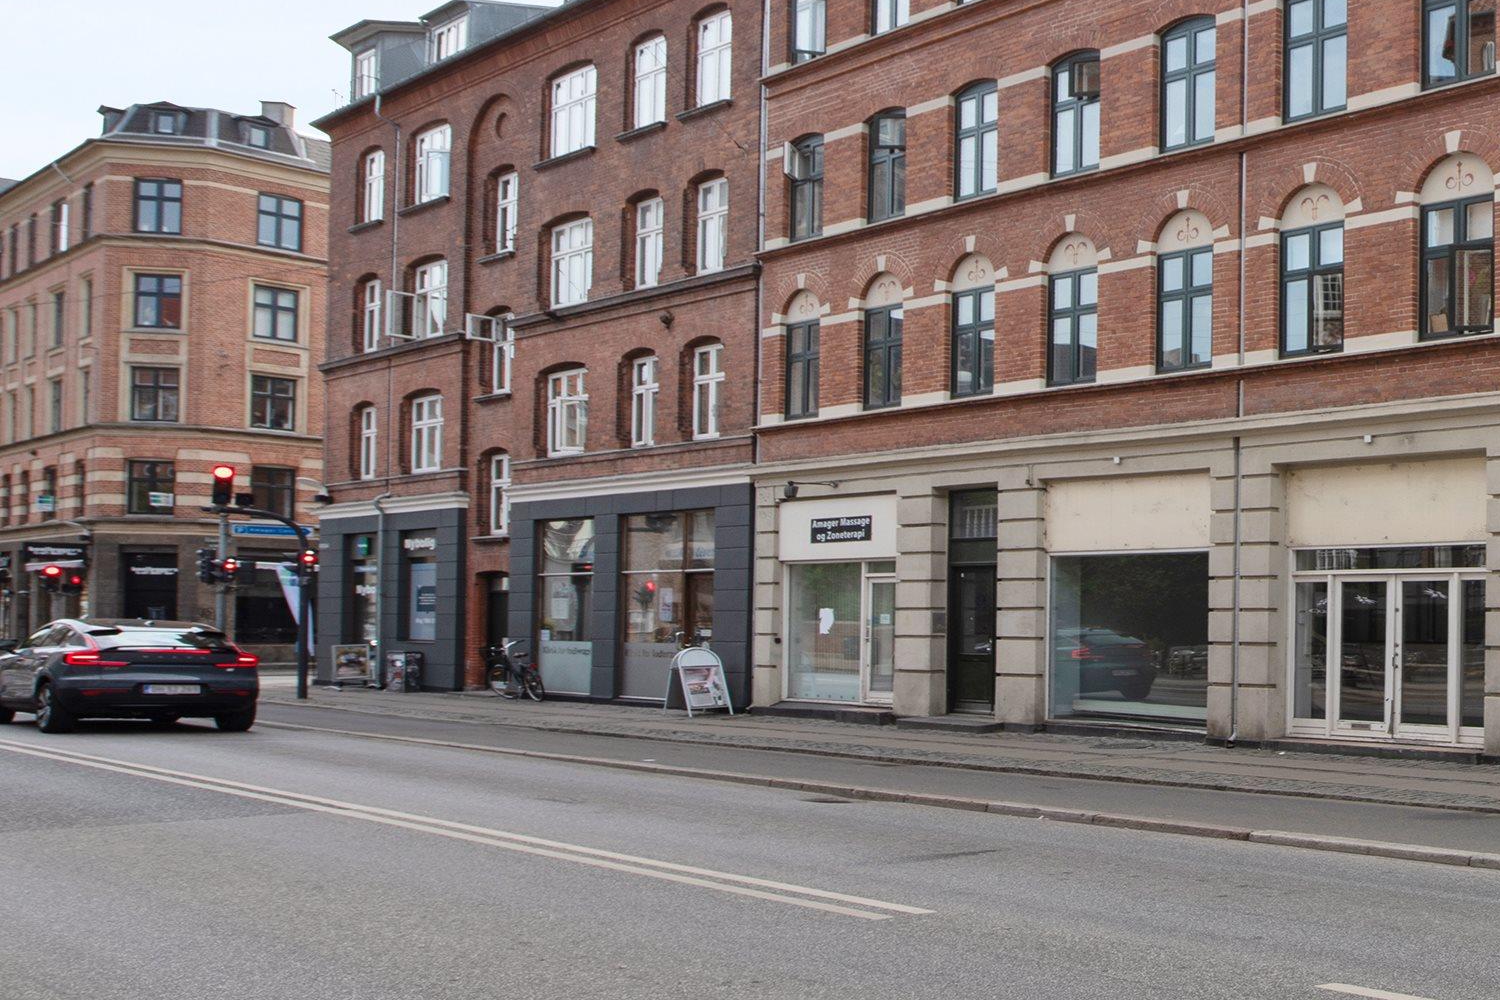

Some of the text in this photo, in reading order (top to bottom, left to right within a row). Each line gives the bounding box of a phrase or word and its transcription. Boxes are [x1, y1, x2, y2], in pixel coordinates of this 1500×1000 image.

[812, 517, 870, 529] Amager Massage
[816, 529, 866, 542] og Zoneterapi
